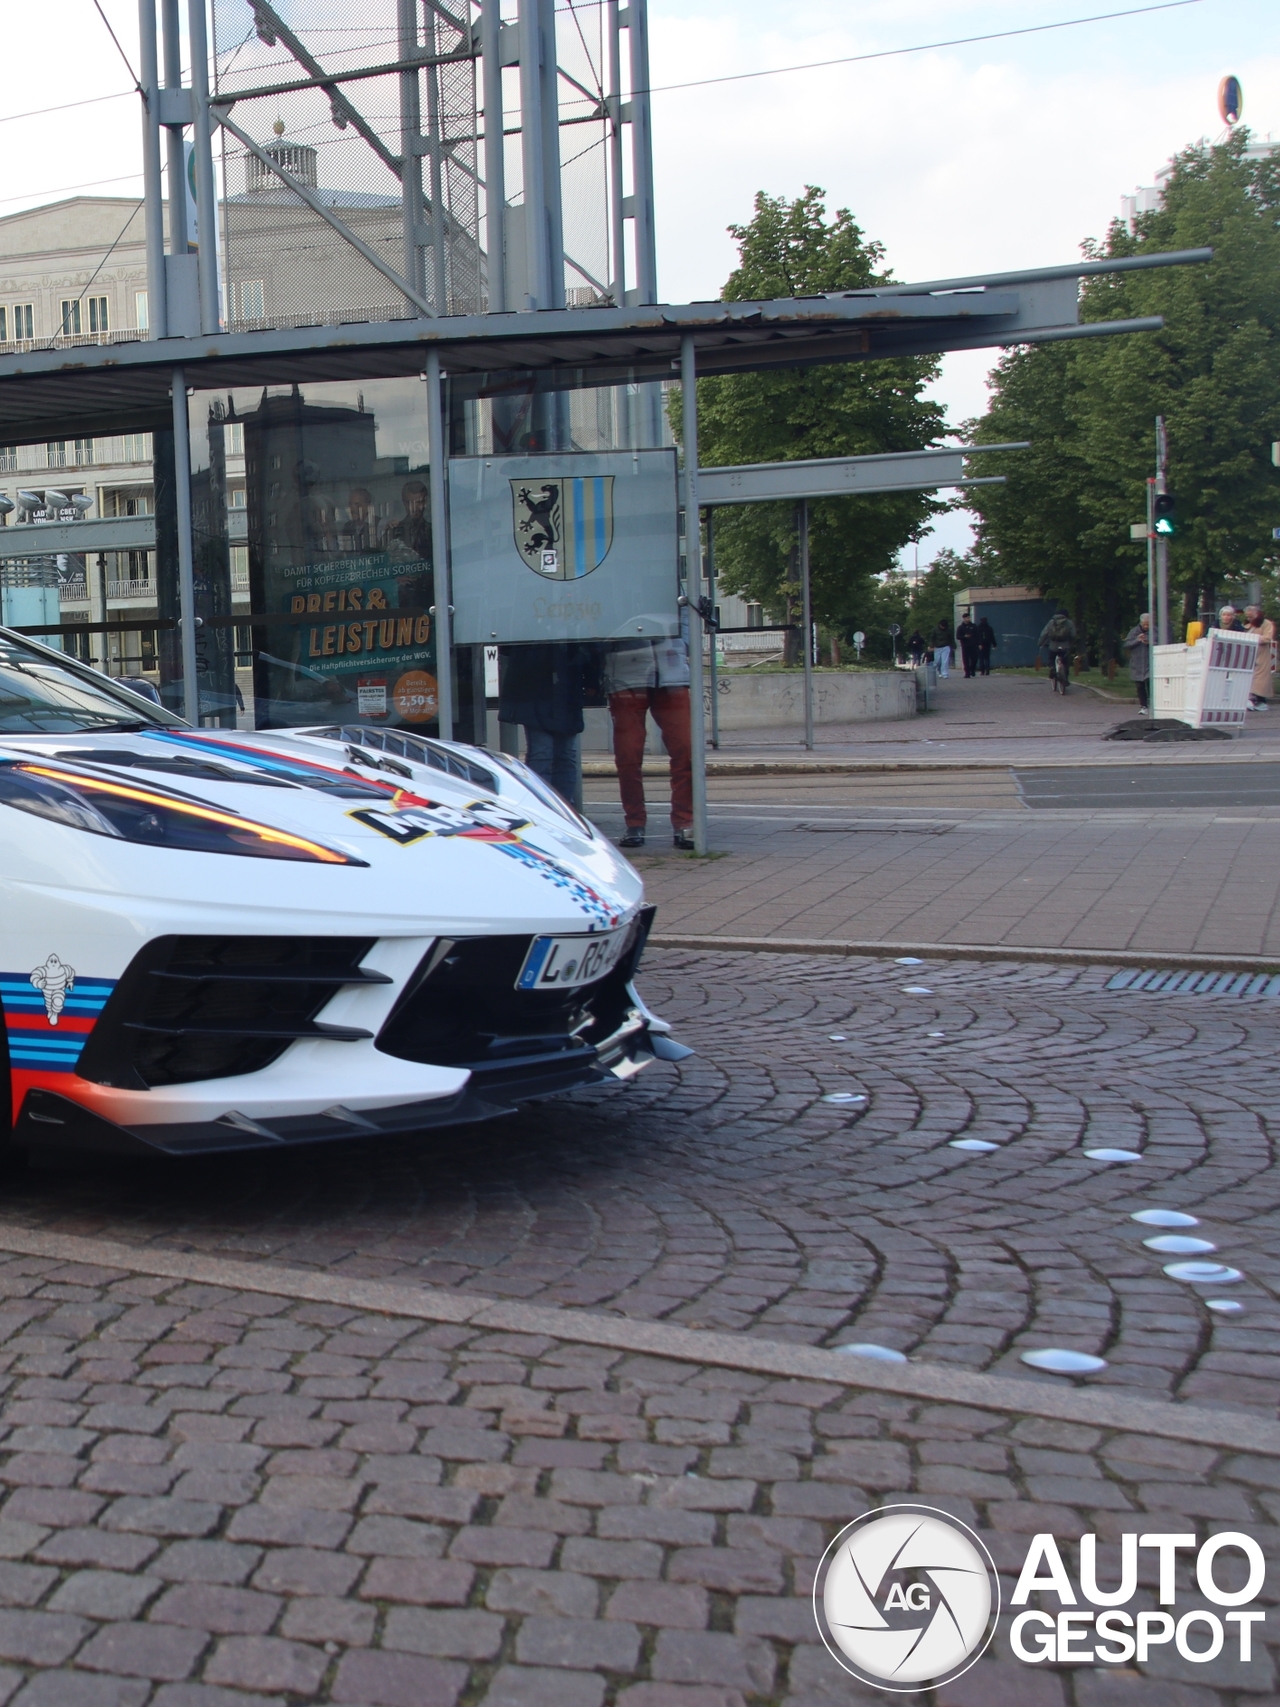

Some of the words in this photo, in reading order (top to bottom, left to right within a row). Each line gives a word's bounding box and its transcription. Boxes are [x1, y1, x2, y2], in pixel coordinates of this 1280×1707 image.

[284, 565, 310, 577] DAMIT
[313, 559, 357, 572] SCHERBEN
[358, 555, 385, 567] NICHT
[296, 577, 312, 588] FÜR
[314, 567, 390, 586] KOPFZERBRECHEN
[392, 563, 431, 575] SORGEN:
[532, 596, 601, 621] Leipzig
[309, 614, 430, 657] LEISTUNG
[309, 664, 320, 672] Die
[321, 656, 401, 671] Haftpflichtversicherung
[401, 653, 413, 661] der
[524, 970, 535, 982] D
[540, 943, 561, 983] L
